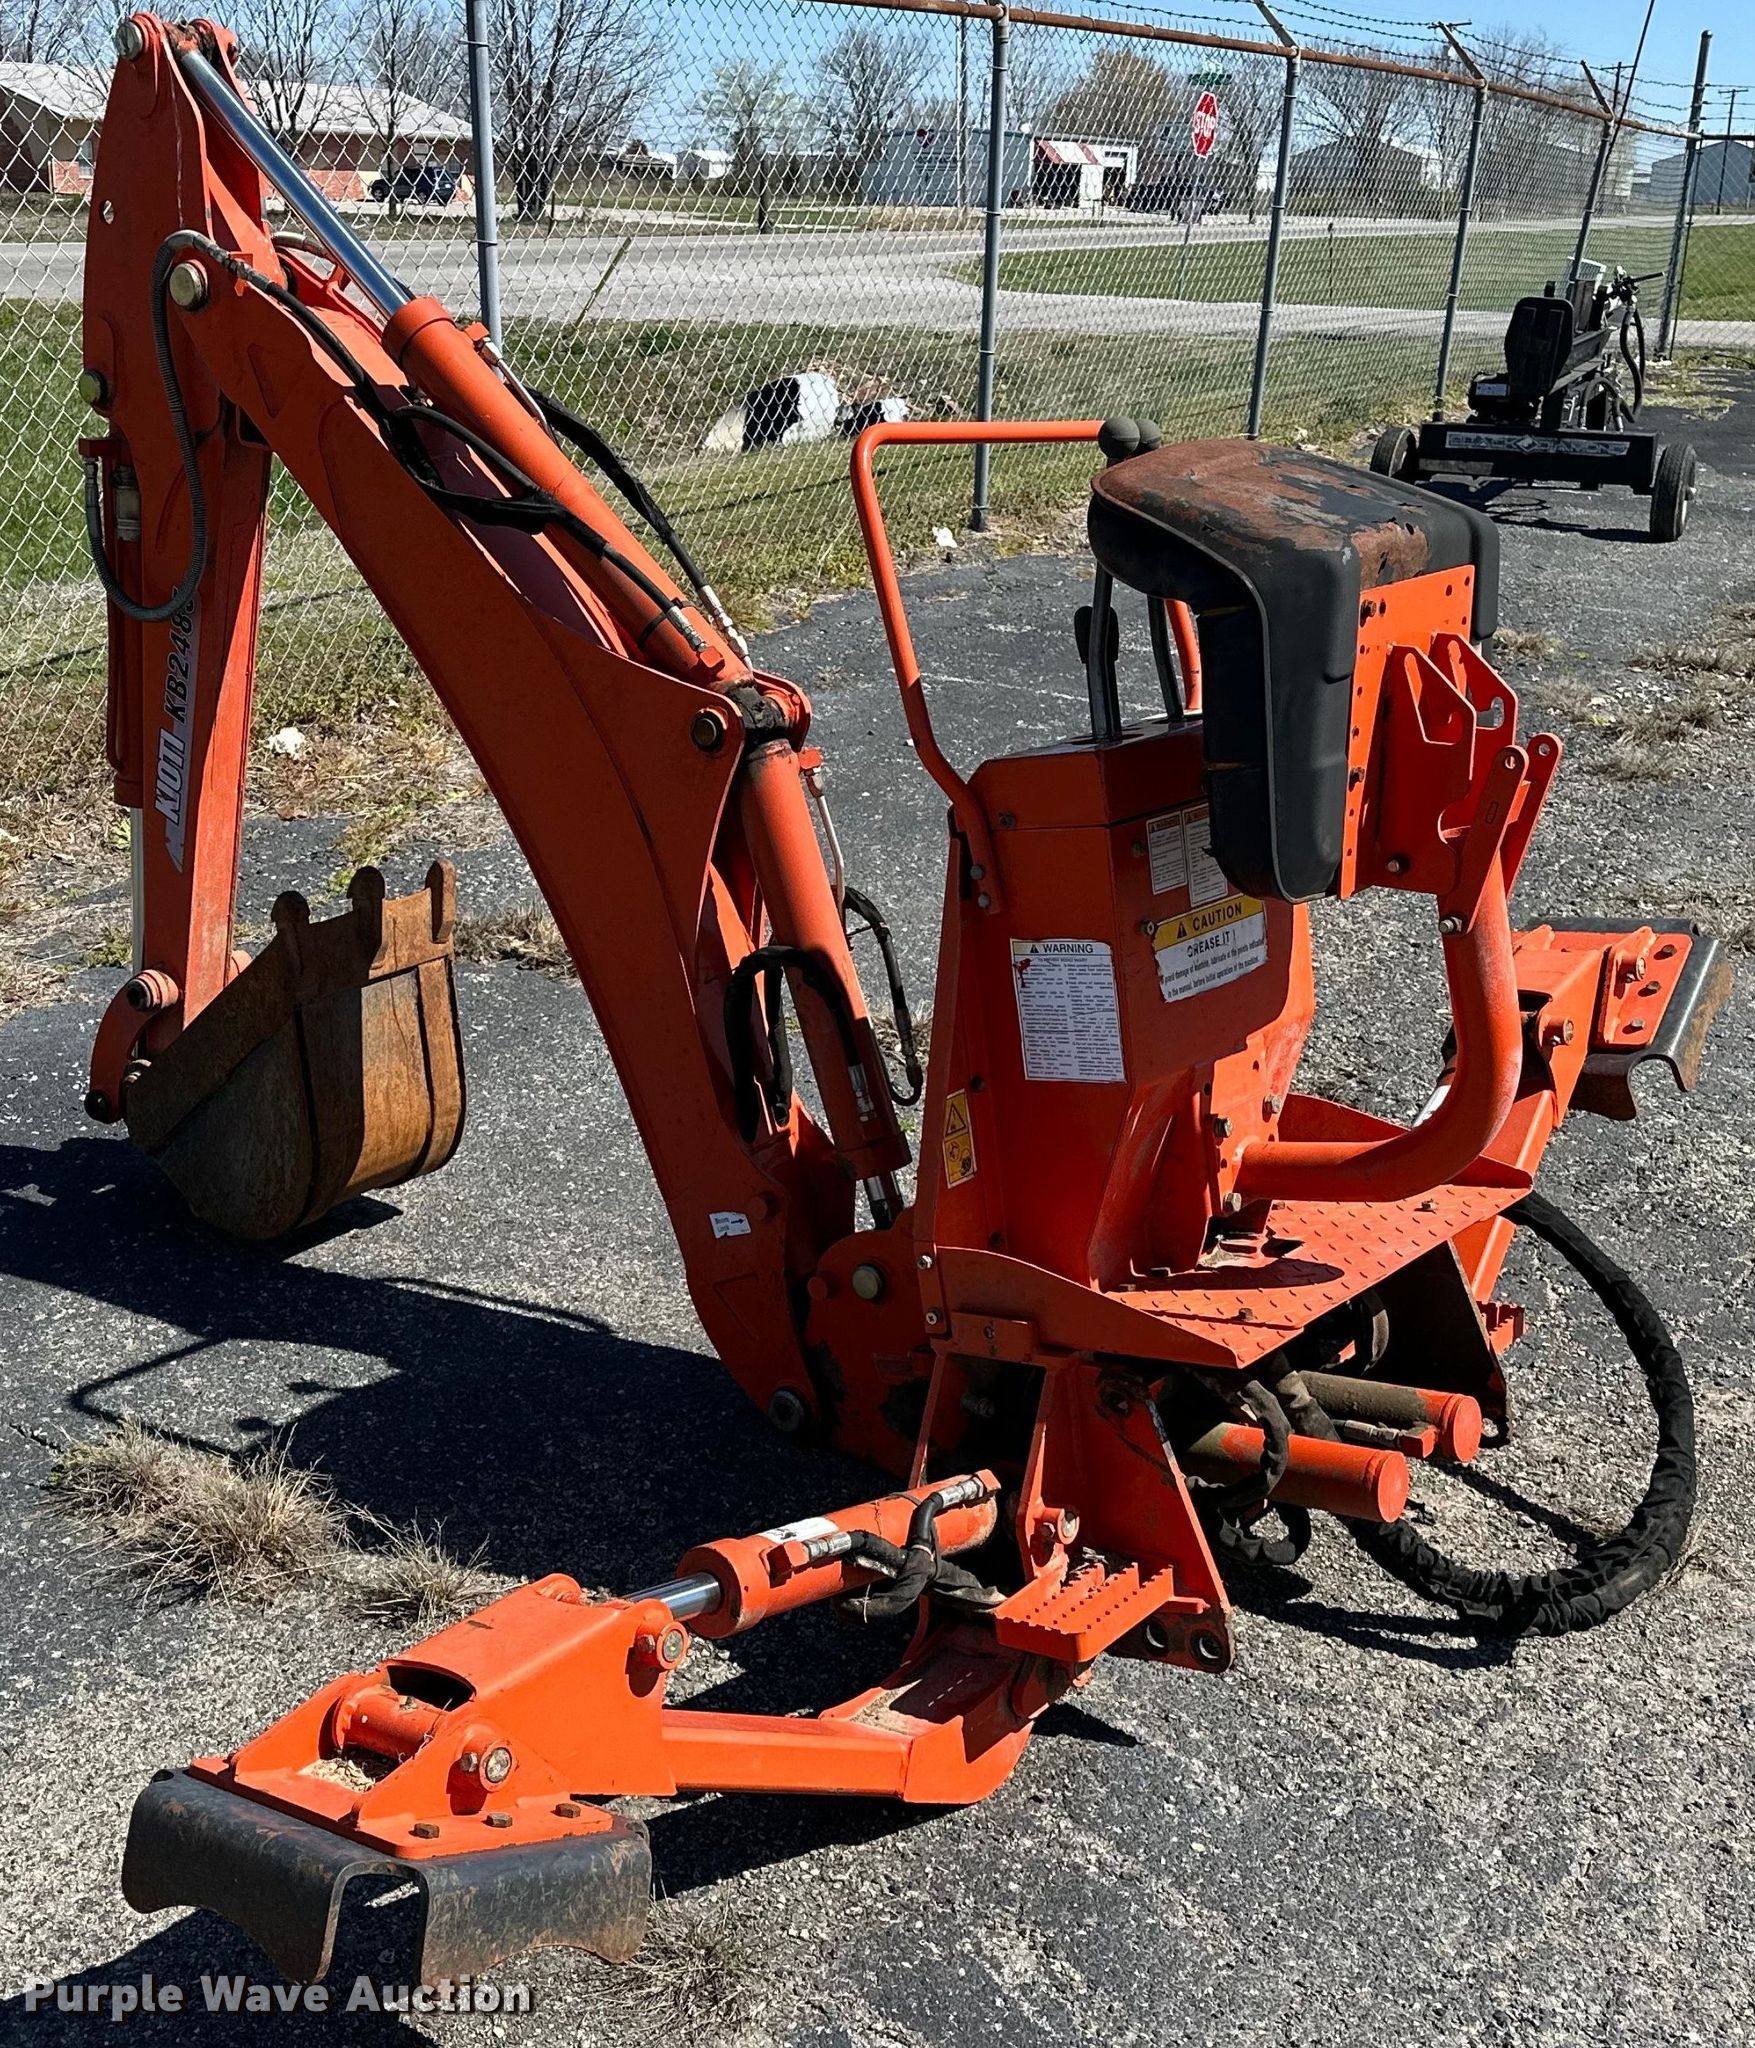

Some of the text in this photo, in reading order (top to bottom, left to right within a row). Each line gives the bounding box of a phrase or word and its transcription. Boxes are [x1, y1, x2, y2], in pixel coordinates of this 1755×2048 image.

[1193, 111, 1216, 137] STOP
[155, 727, 185, 826] KIOTI
[1193, 902, 1242, 931] CAUTION
[1043, 943, 1093, 954] WARNING
[1187, 935, 1219, 957] GREASE
[1222, 931, 1230, 945] IT
